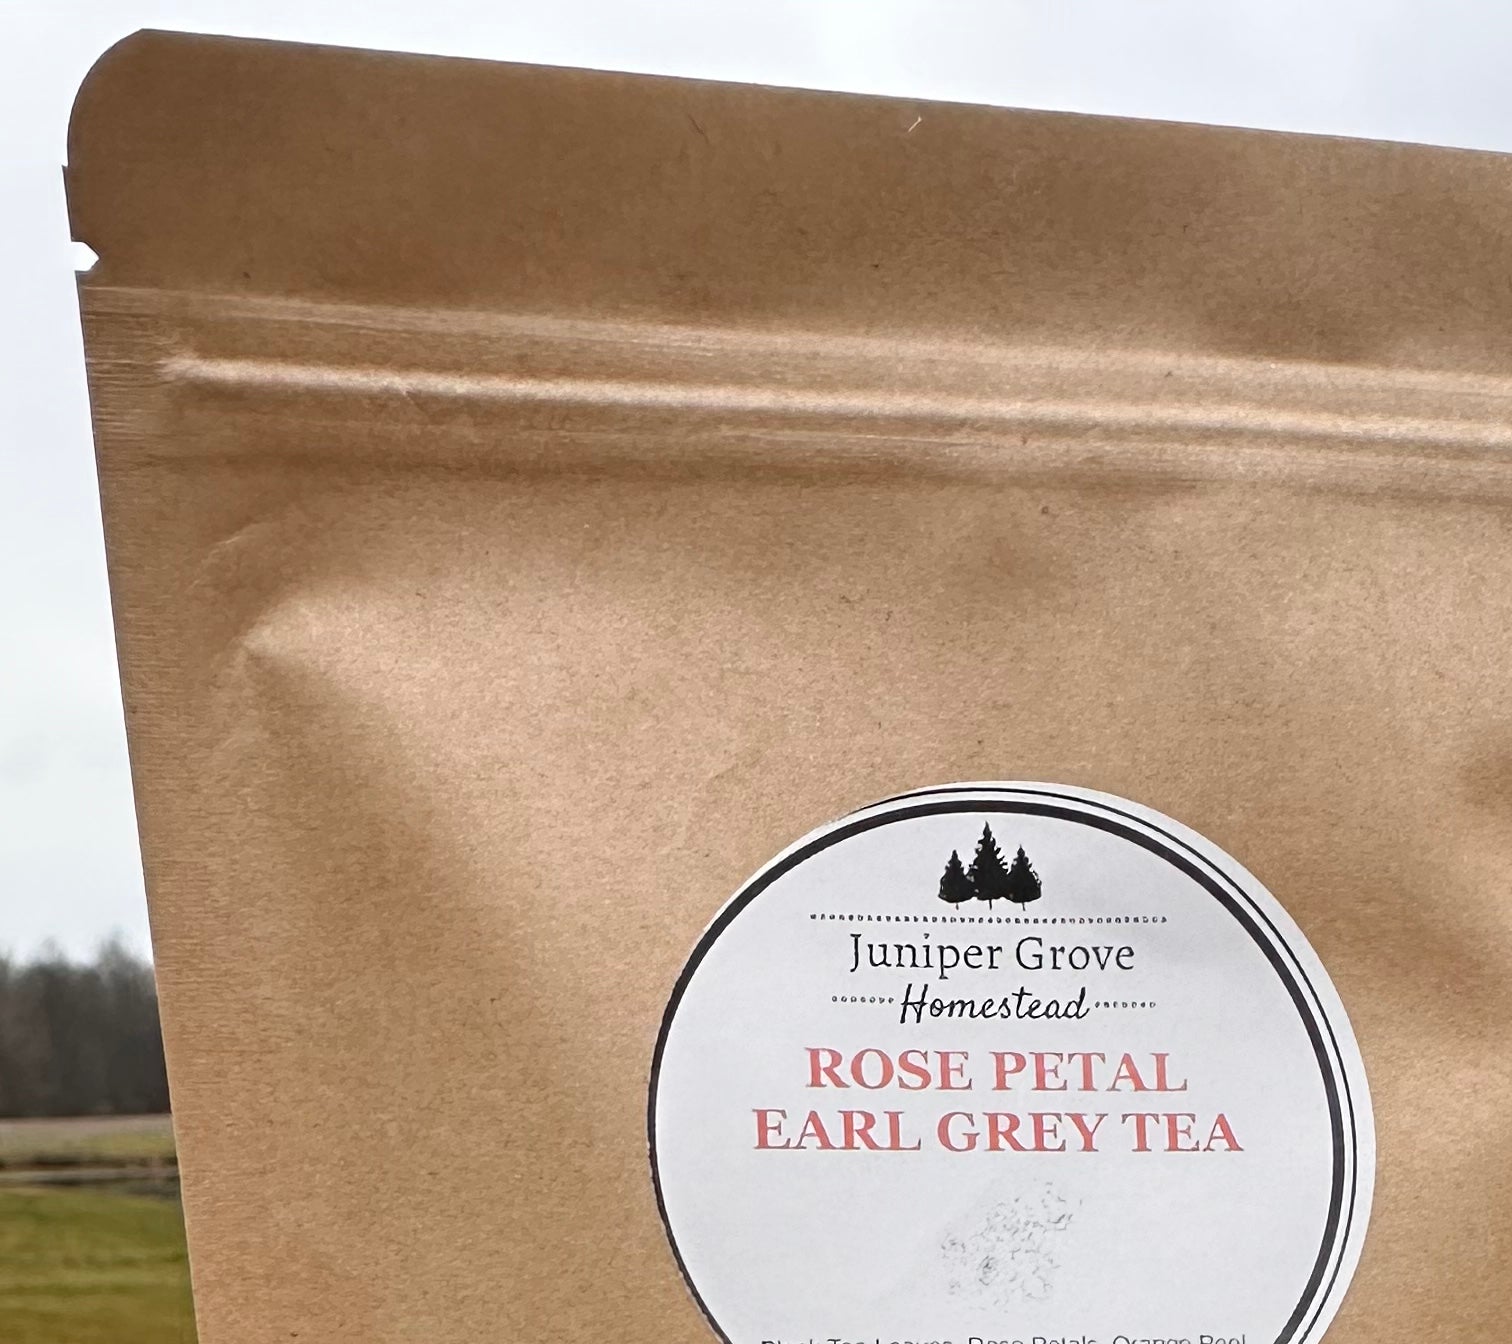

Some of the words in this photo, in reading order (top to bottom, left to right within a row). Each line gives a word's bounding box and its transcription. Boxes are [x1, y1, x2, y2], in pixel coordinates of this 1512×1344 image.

[849, 932, 1003, 979] Juniper
[1014, 935, 1136, 972] Grove
[899, 984, 1090, 1024] Homestead
[804, 1047, 974, 1091] ROSE
[989, 1051, 1189, 1092] PETAL
[752, 1107, 921, 1151] EARL
[937, 1112, 1107, 1153] GREY
[1121, 1113, 1244, 1153] TEA
